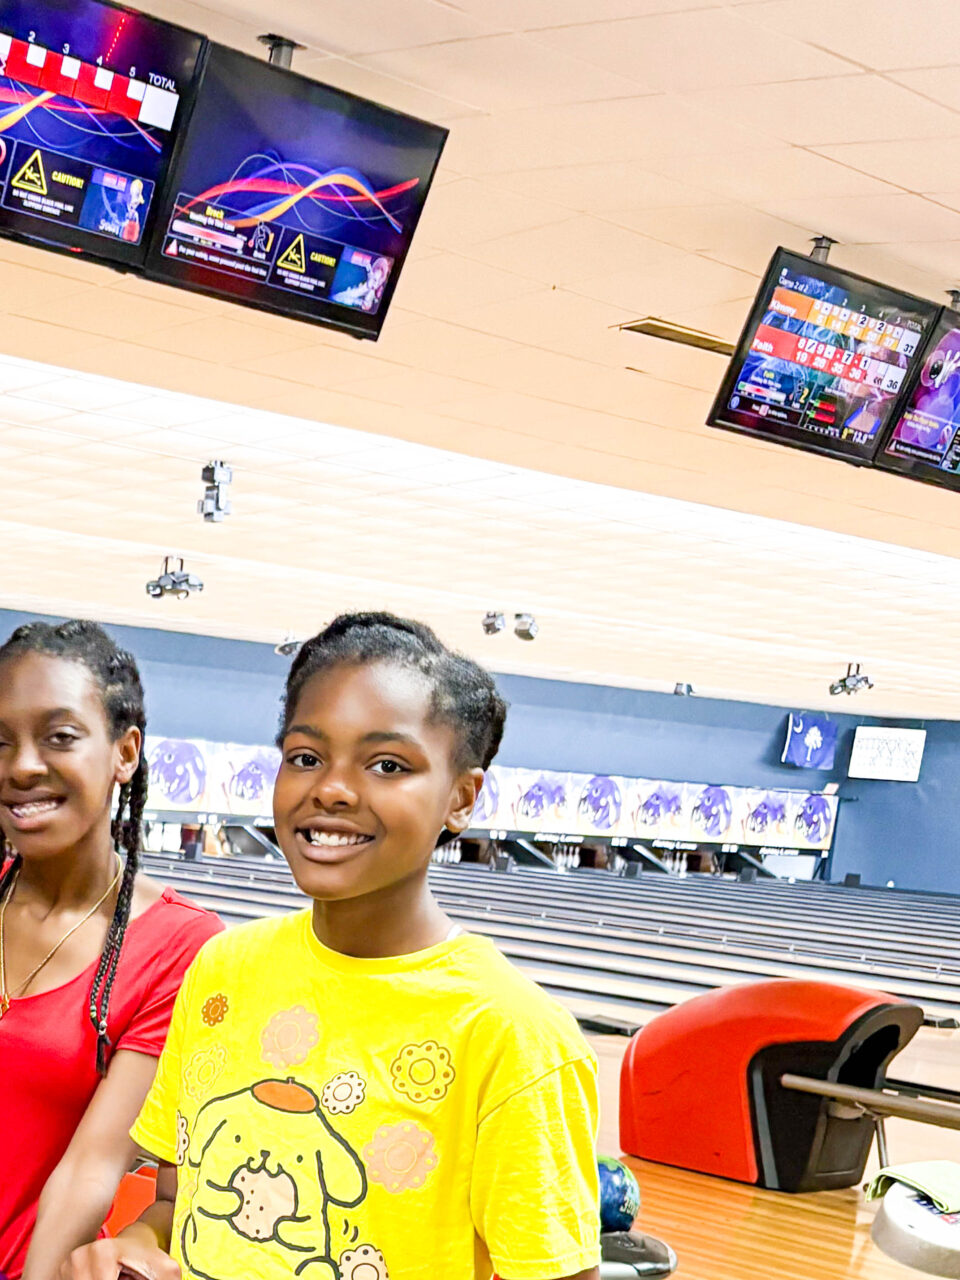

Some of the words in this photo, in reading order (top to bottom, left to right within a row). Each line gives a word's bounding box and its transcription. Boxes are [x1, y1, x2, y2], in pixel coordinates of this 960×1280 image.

[28, 31, 36, 42] 2
[63, 43, 70, 54] 3
[96, 56, 103, 66] 4
[129, 66, 136, 77] 5
[148, 72, 177, 92] TOTAL
[51, 170, 84, 189] CAUTION!
[859, 316, 867, 325] 2
[877, 322, 885, 331] 2
[903, 343, 914, 354] 37
[844, 354, 851, 363] 7
[886, 379, 898, 390] 36
